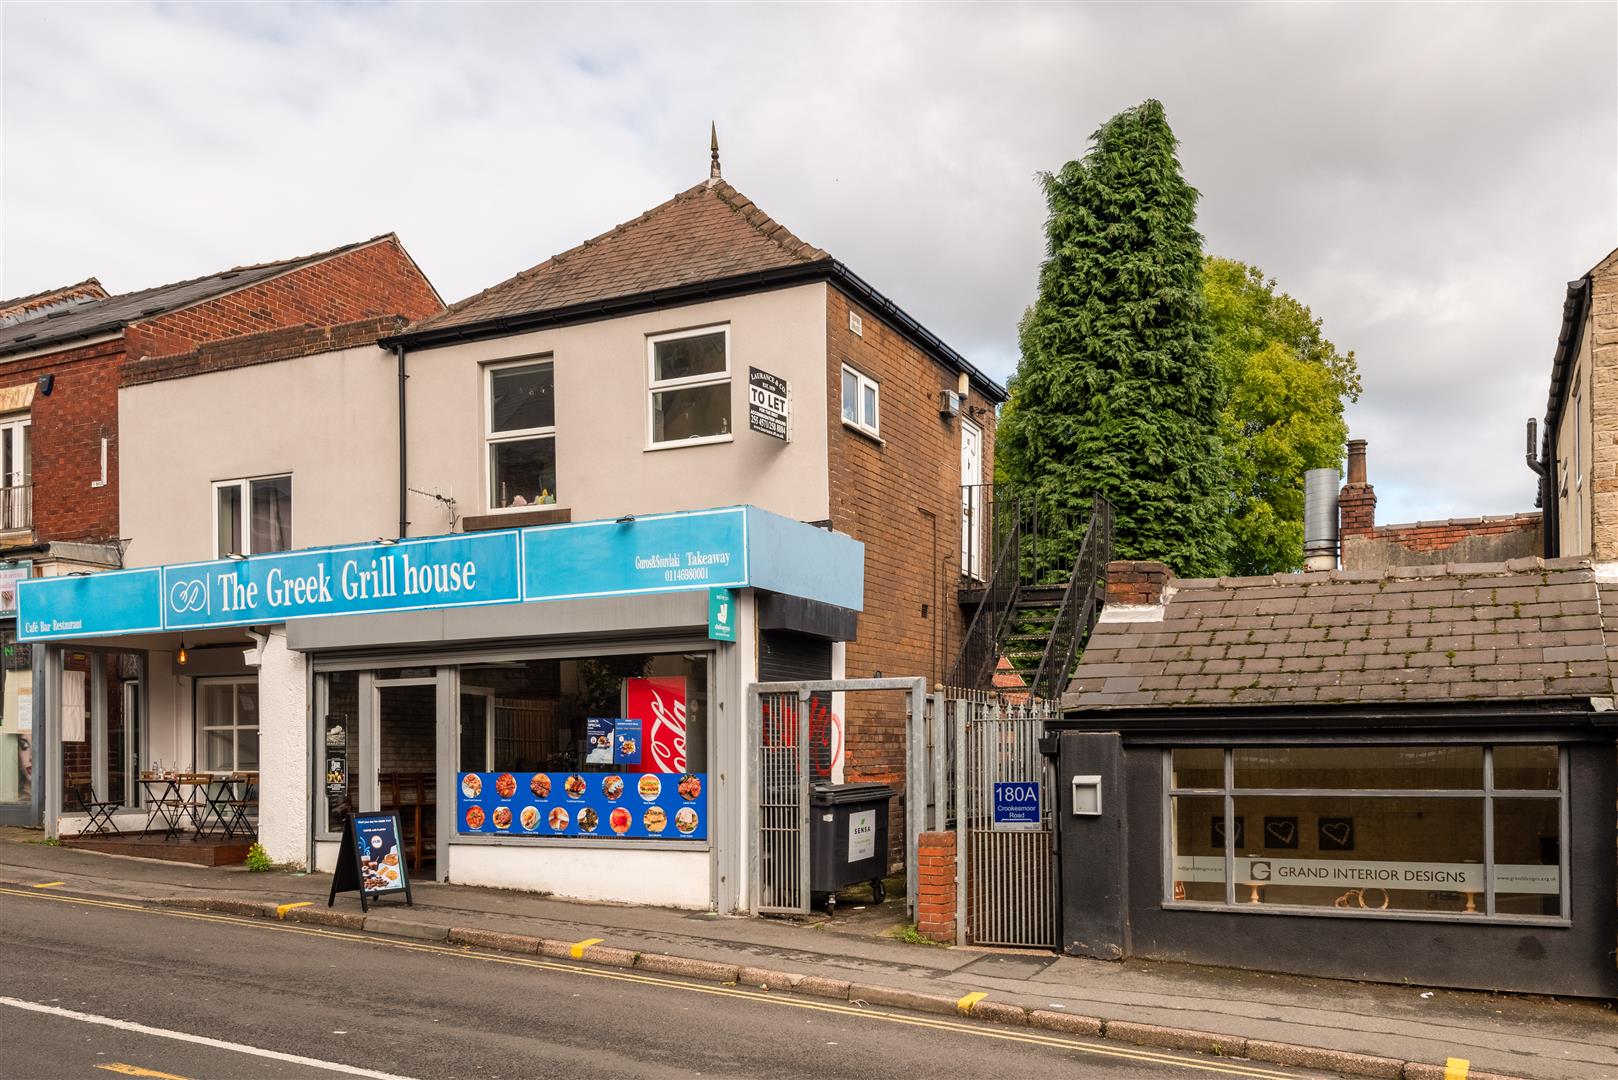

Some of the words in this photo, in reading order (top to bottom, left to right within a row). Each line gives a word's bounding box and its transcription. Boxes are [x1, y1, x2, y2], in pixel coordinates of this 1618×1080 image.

[750, 372, 775, 384] LAURANCE
[752, 387, 765, 405] TO
[768, 394, 785, 413] LET
[686, 551, 730, 567] Takeaway
[218, 573, 258, 611] The
[266, 563, 333, 607] Greek
[341, 555, 397, 600] Grill
[402, 555, 476, 595] house
[25, 621, 39, 633] Café
[40, 621, 51, 632] Bar
[53, 620, 82, 631] Restaurant
[996, 786, 1037, 802] 180A
[854, 826, 871, 835] SENSA
[1278, 866, 1329, 879] GRAND
[1333, 868, 1400, 881] INTERIOR
[1404, 870, 1466, 883] DESIGNS
